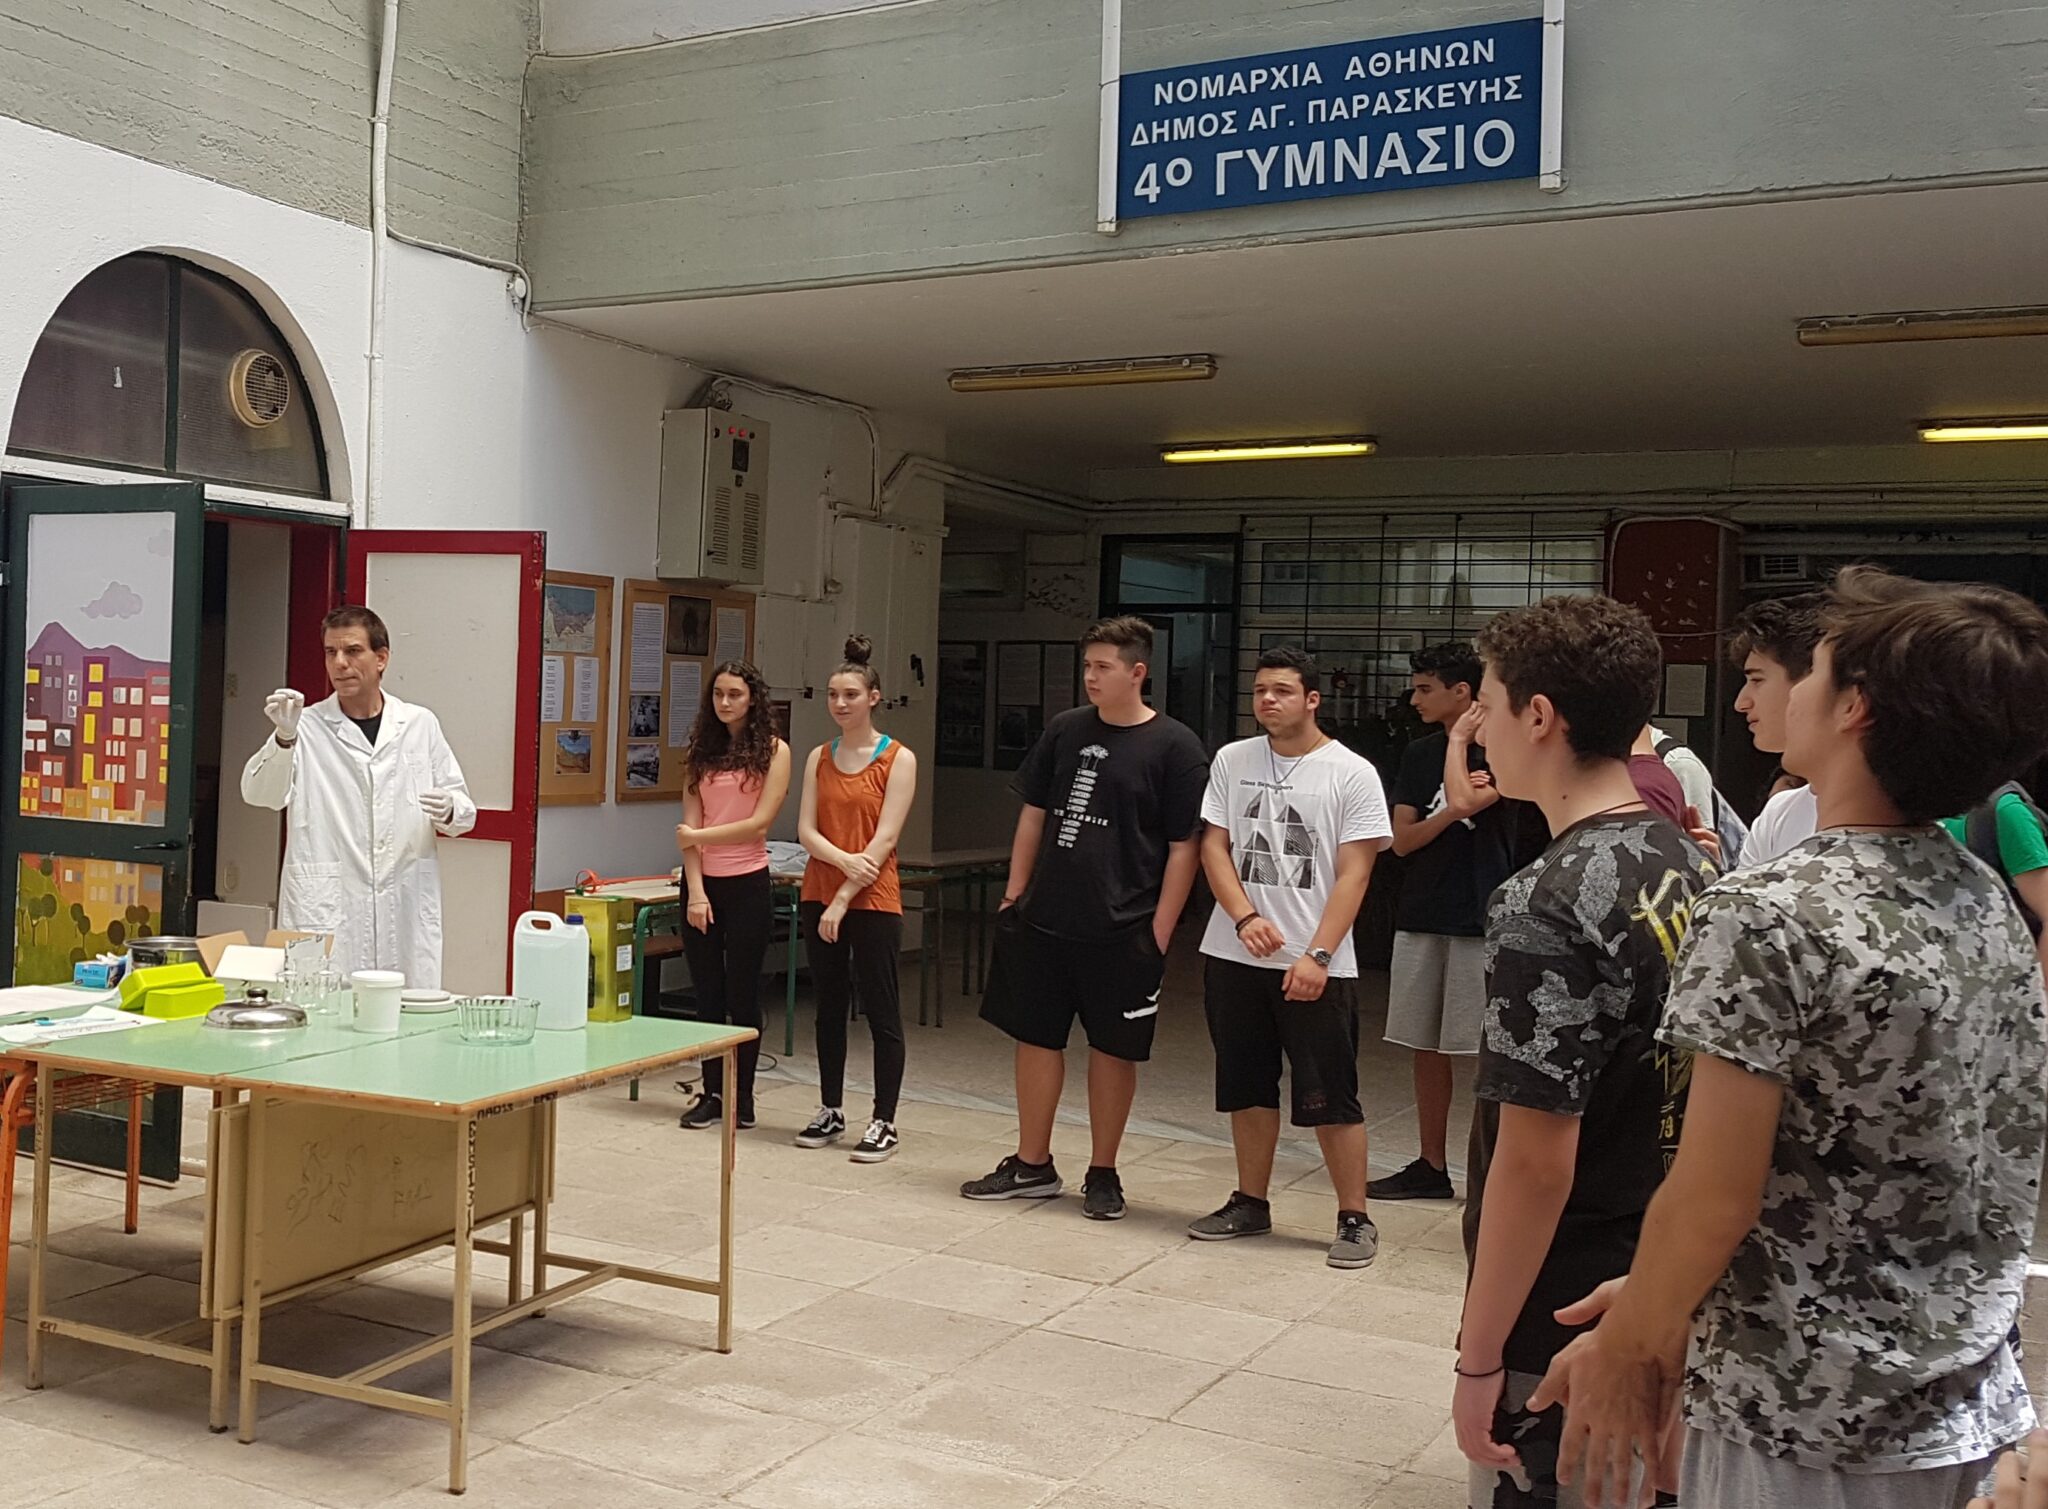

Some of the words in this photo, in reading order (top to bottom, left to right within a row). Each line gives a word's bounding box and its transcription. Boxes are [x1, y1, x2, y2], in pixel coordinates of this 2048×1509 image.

[1153, 61, 1323, 106] ΝΟΜΑΡΧΙΑ
[1344, 38, 1495, 82] ΑΘΗΝΩΝ
[1129, 108, 1238, 147] ΔΗΜΟΣ
[1247, 103, 1295, 132] ΑΓ.
[1307, 74, 1523, 124] ΠΑΡΑΣΚΕΥΗΣ
[1214, 118, 1516, 196] ΓΥΜΝΑΣΙΟ
